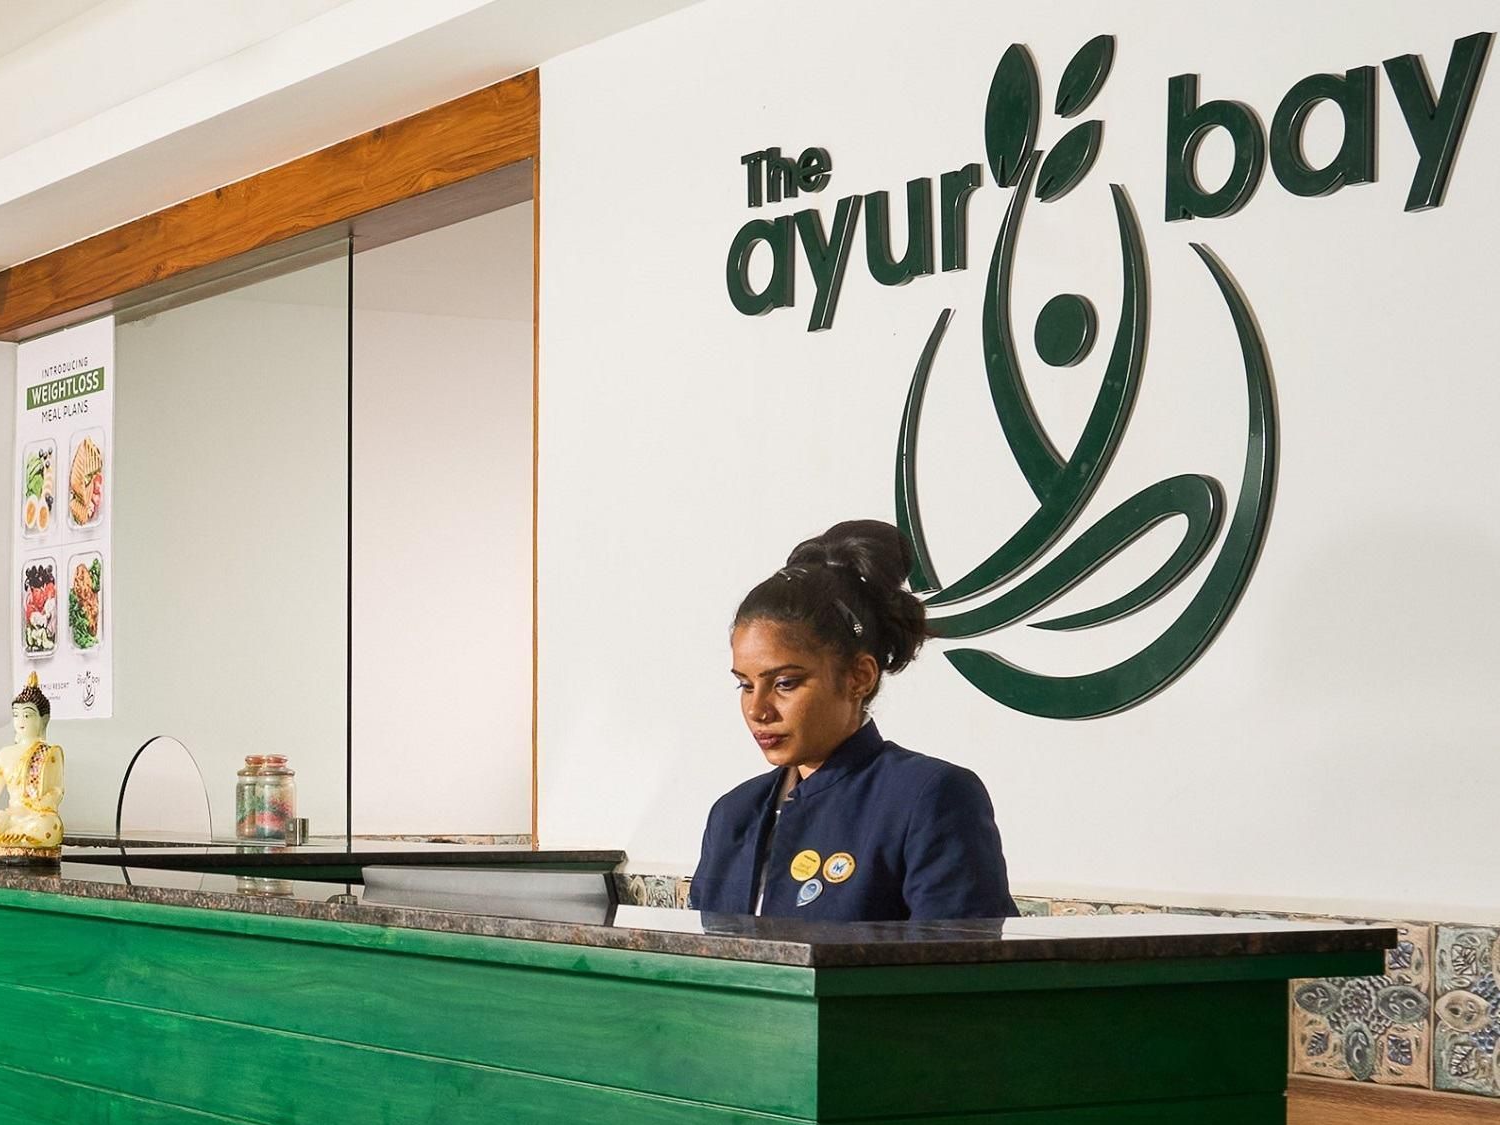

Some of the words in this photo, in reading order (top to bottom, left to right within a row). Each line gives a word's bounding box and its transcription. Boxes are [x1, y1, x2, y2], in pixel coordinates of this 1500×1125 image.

[726, 163, 983, 332] ayur
[1164, 31, 1497, 223] bay
[740, 146, 833, 208] The
[41, 356, 89, 378] INTRODUCING
[32, 371, 99, 405] WEIGHTLOSS
[41, 408, 62, 424] MEAL
[63, 400, 89, 417] PLANS
